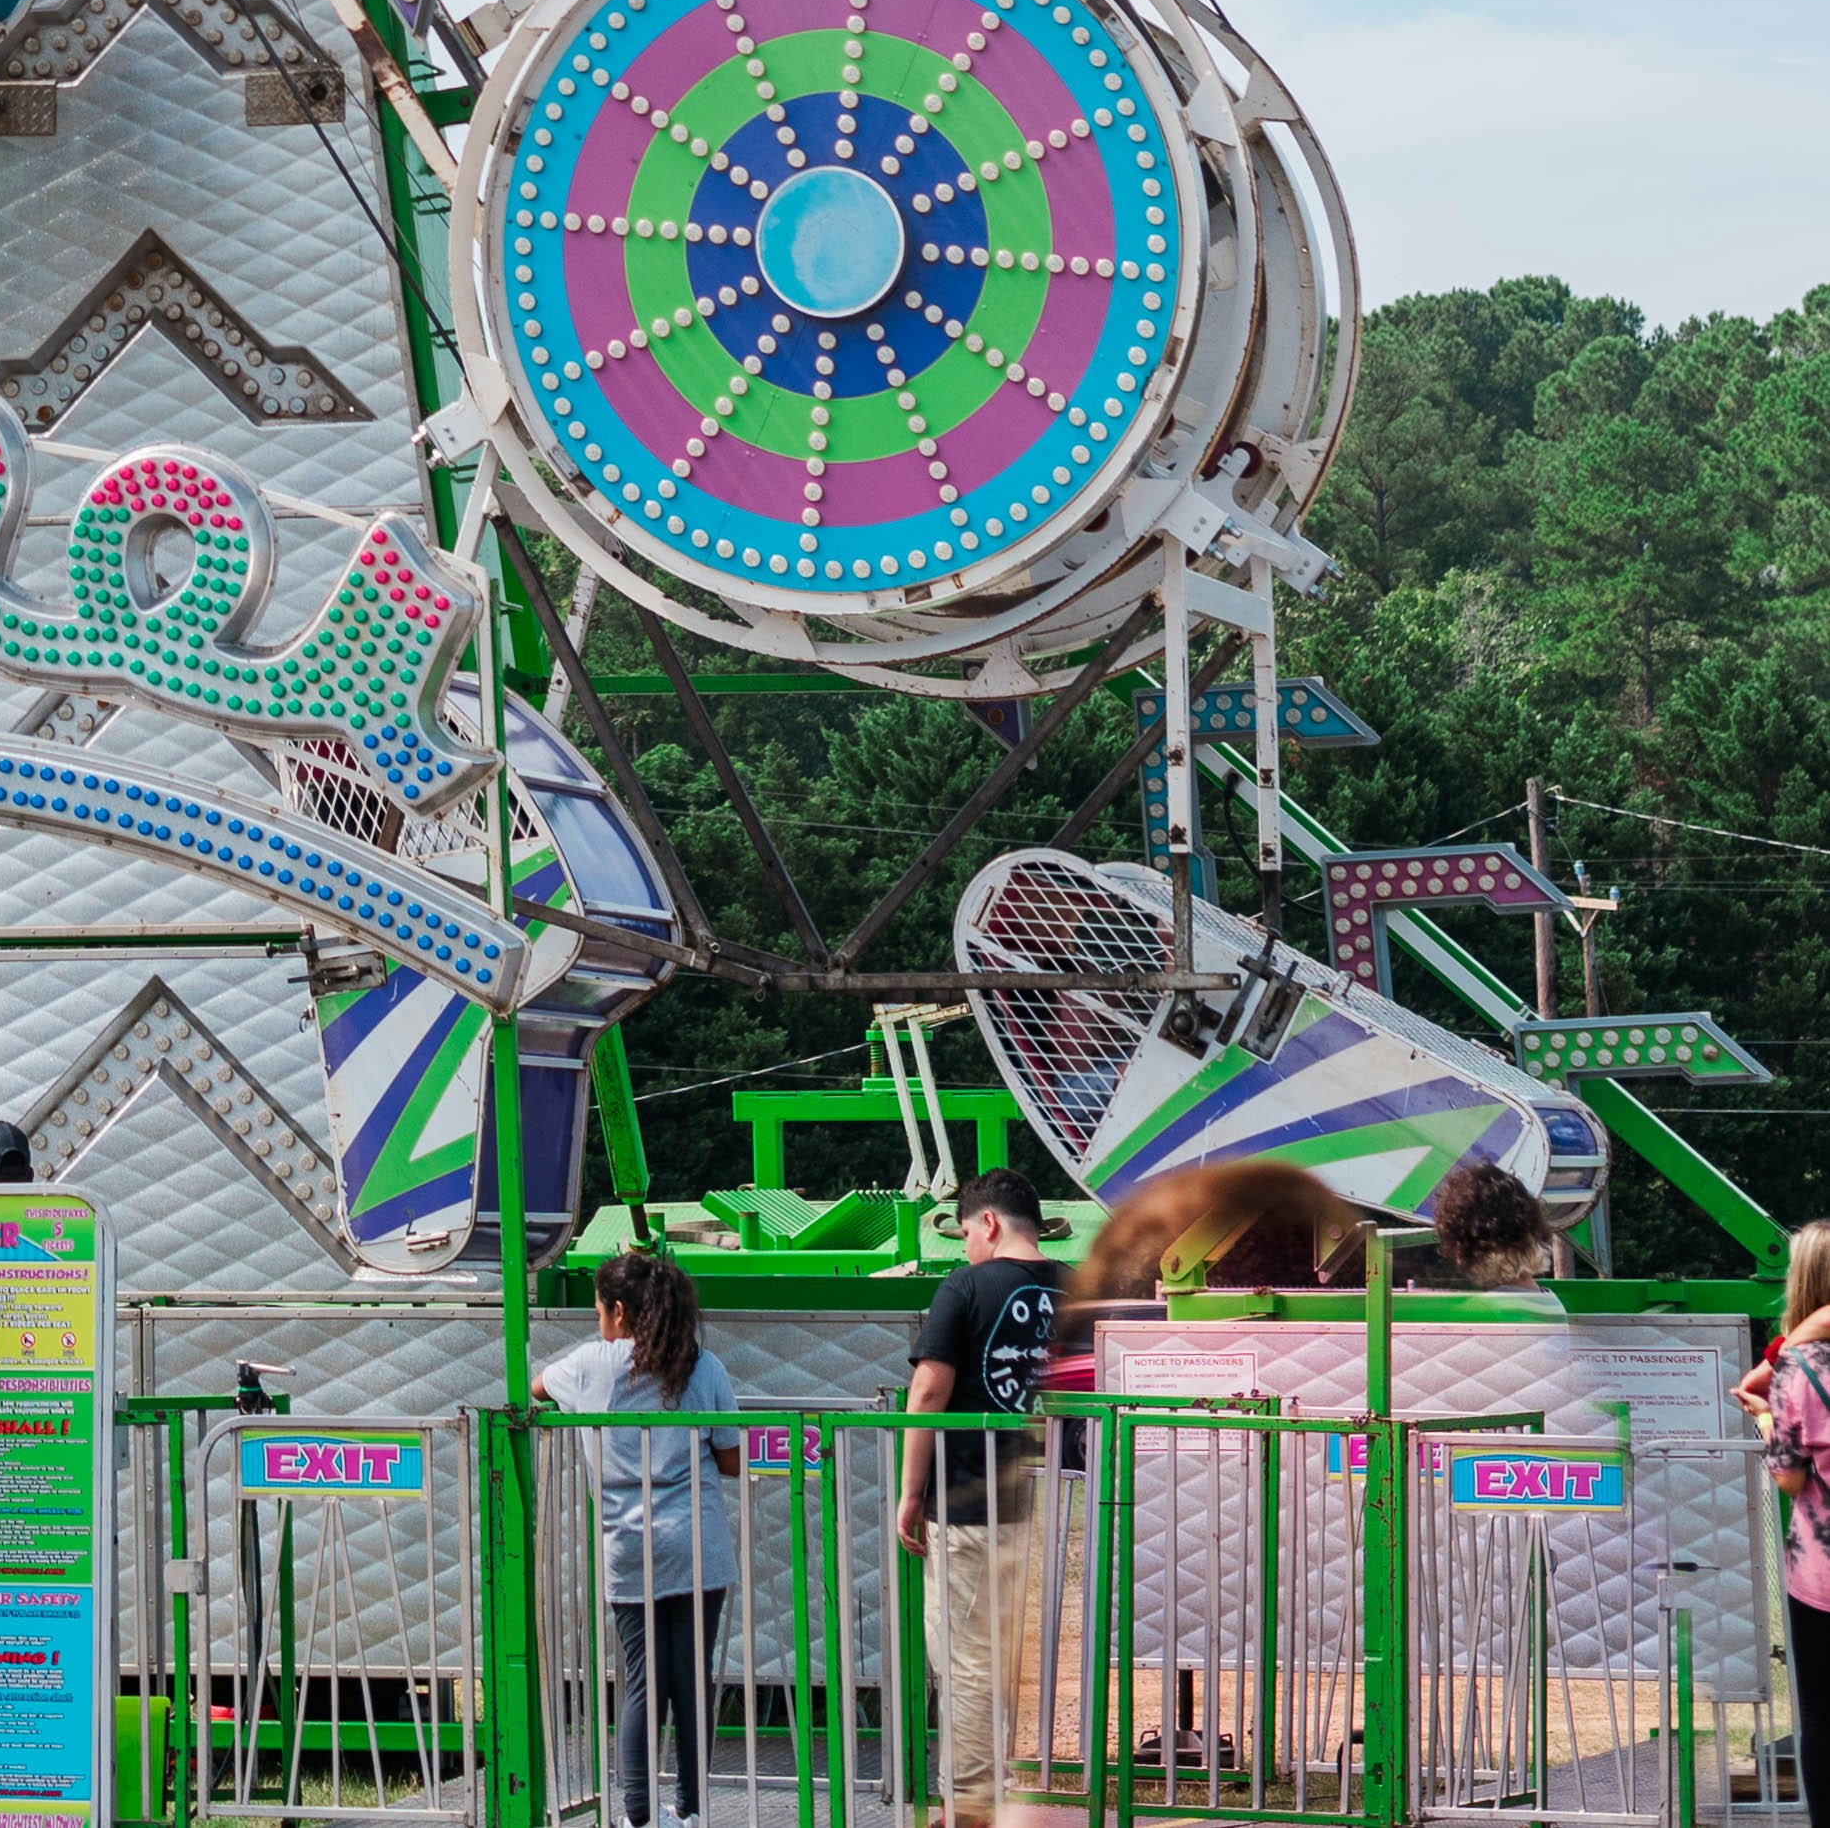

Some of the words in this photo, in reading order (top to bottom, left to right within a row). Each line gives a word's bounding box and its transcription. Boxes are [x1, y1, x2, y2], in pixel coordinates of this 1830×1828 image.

[1134, 1358, 1167, 1366] NOTICE
[1170, 1358, 1182, 1366] TO
[1183, 1358, 1244, 1366] PASSENGERS
[1613, 1355, 1627, 1363] TO
[1630, 1354, 1705, 1364] PASSENGERS
[264, 1443, 400, 1483] EXIT
[1474, 1461, 1601, 1500] EXIT
[17, 1593, 81, 1606] SAFETY
